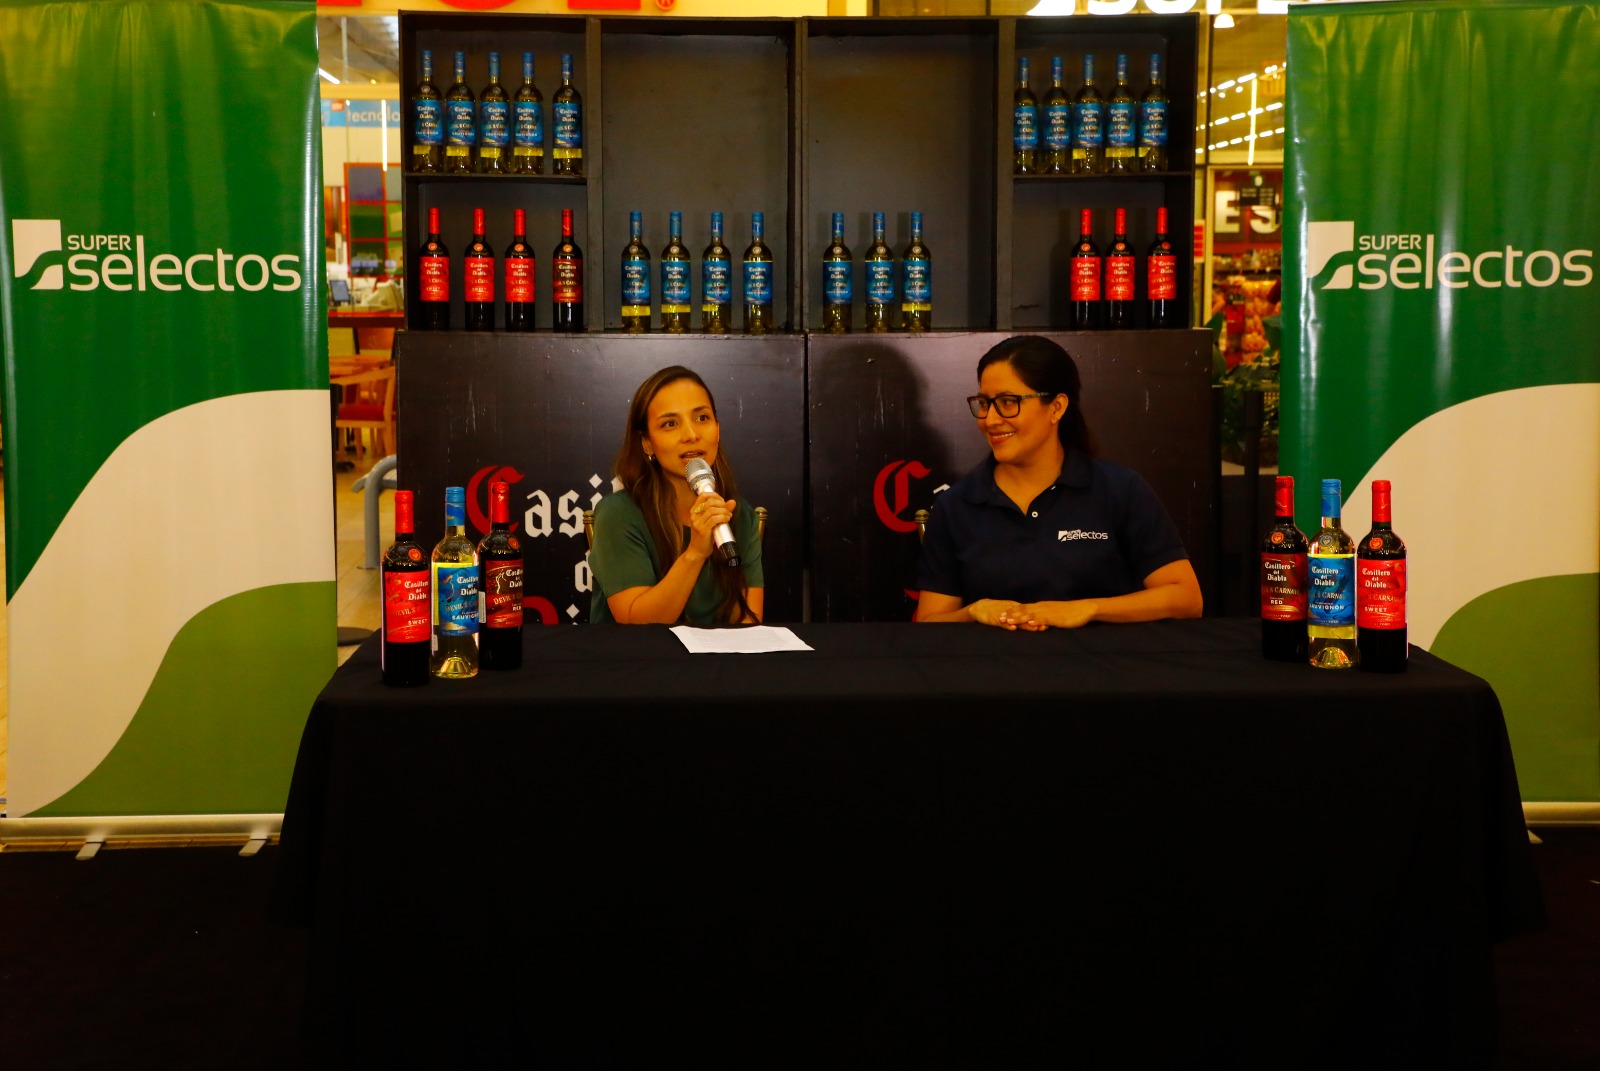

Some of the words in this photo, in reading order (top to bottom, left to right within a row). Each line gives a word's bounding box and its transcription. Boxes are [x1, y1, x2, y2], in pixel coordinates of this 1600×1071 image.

[67, 234, 131, 250] SUPER
[1358, 234, 1422, 250] SUPER
[67, 234, 302, 292] selectos
[1357, 234, 1593, 290] selectos
[1066, 530, 1108, 540] selectos
[1312, 566, 1338, 574] Casillero
[1365, 580, 1387, 588] Diablo
